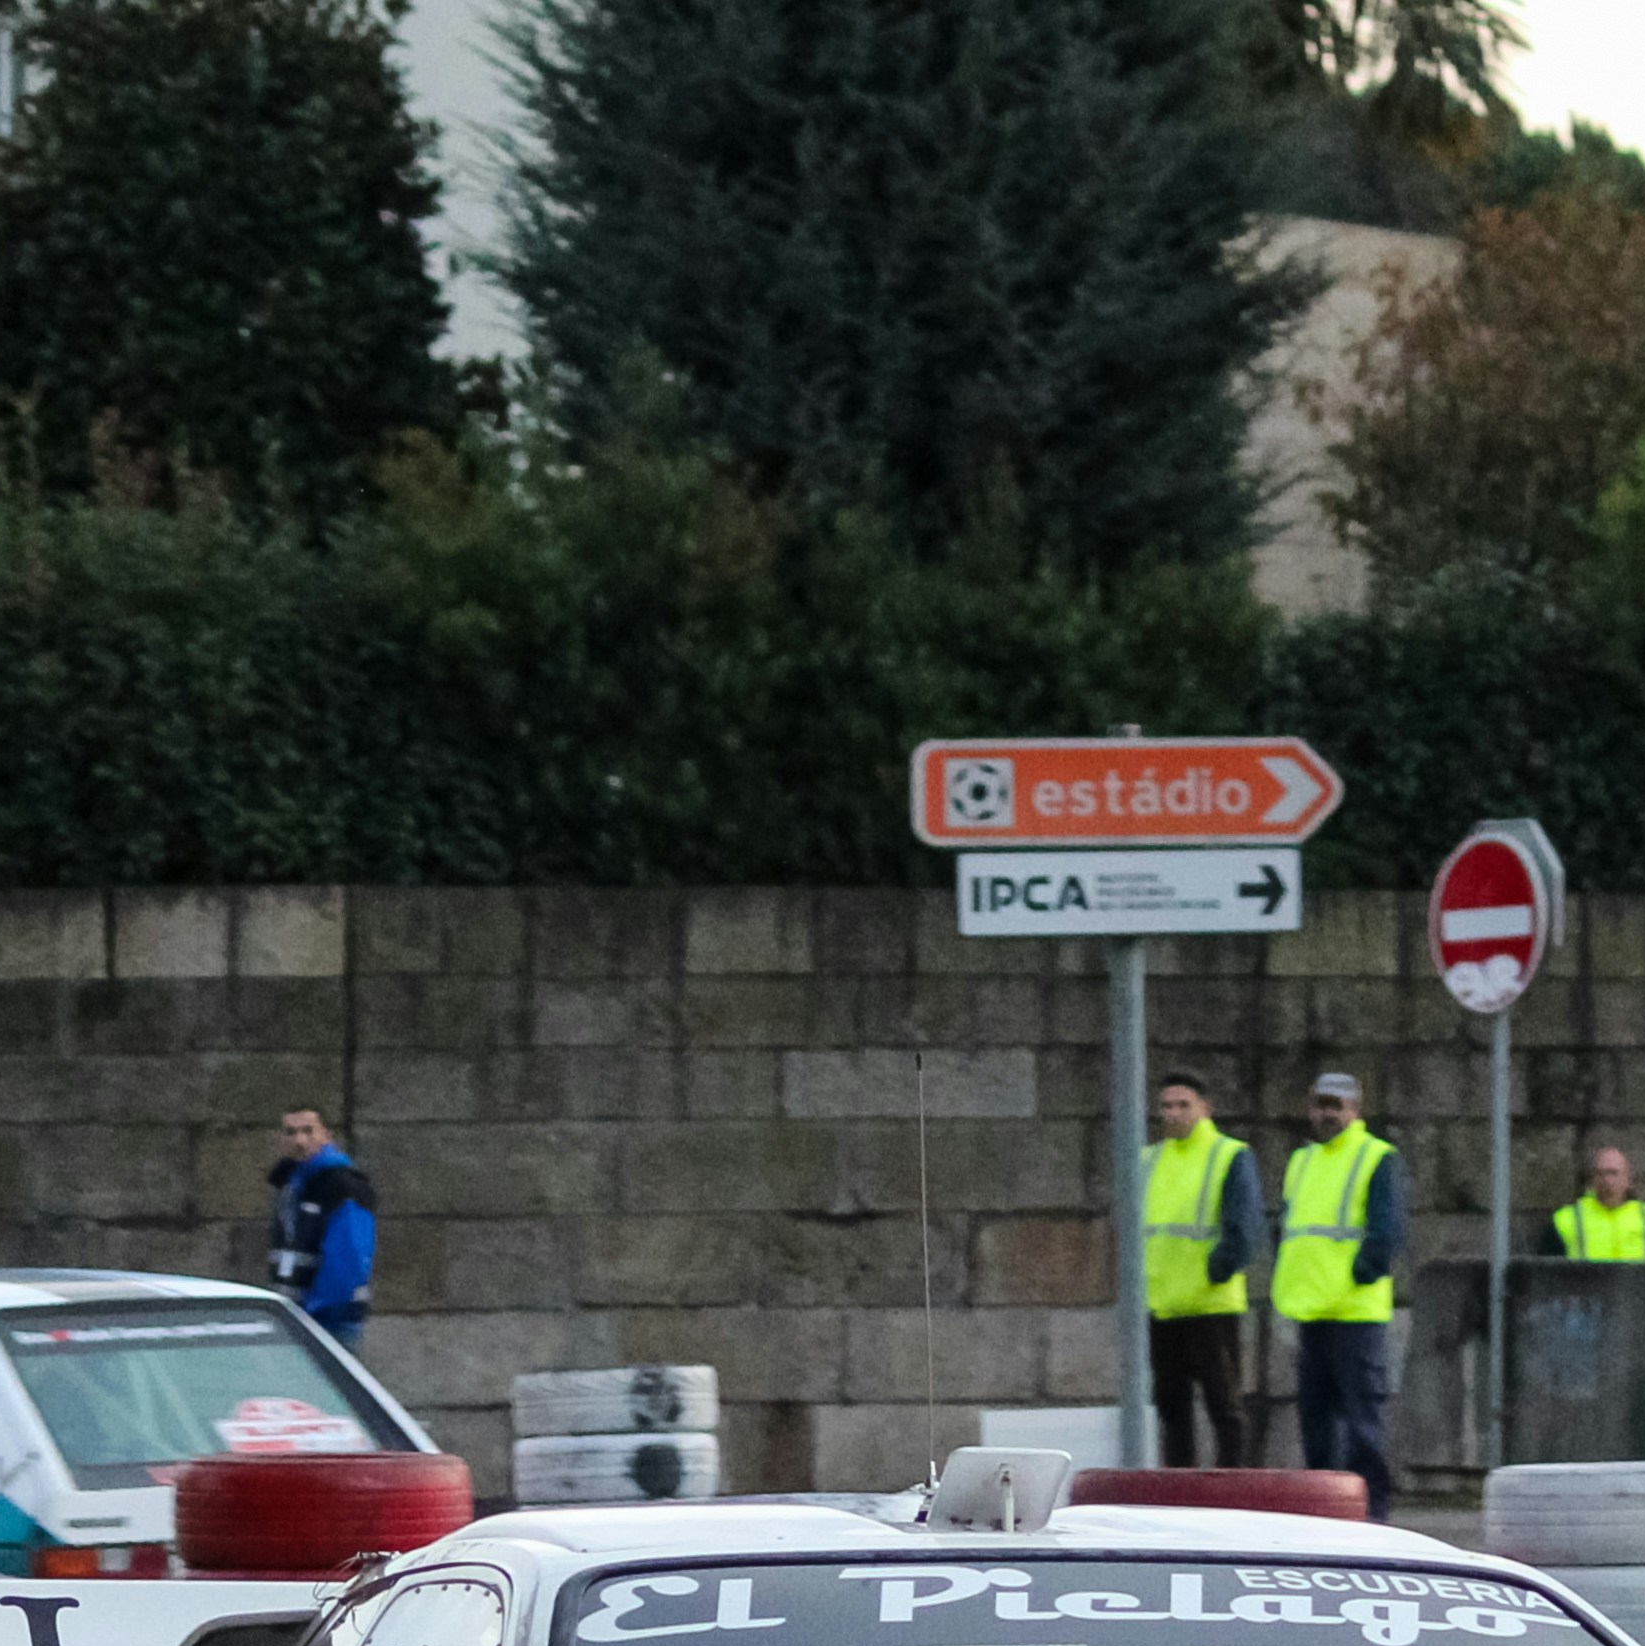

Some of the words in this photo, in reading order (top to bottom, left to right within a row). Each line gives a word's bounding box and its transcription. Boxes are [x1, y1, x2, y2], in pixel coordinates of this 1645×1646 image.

[1033, 765, 1252, 817] estádio
[972, 876, 1089, 911] IPCA
[1233, 1569, 1564, 1614] ESCUDERIA
